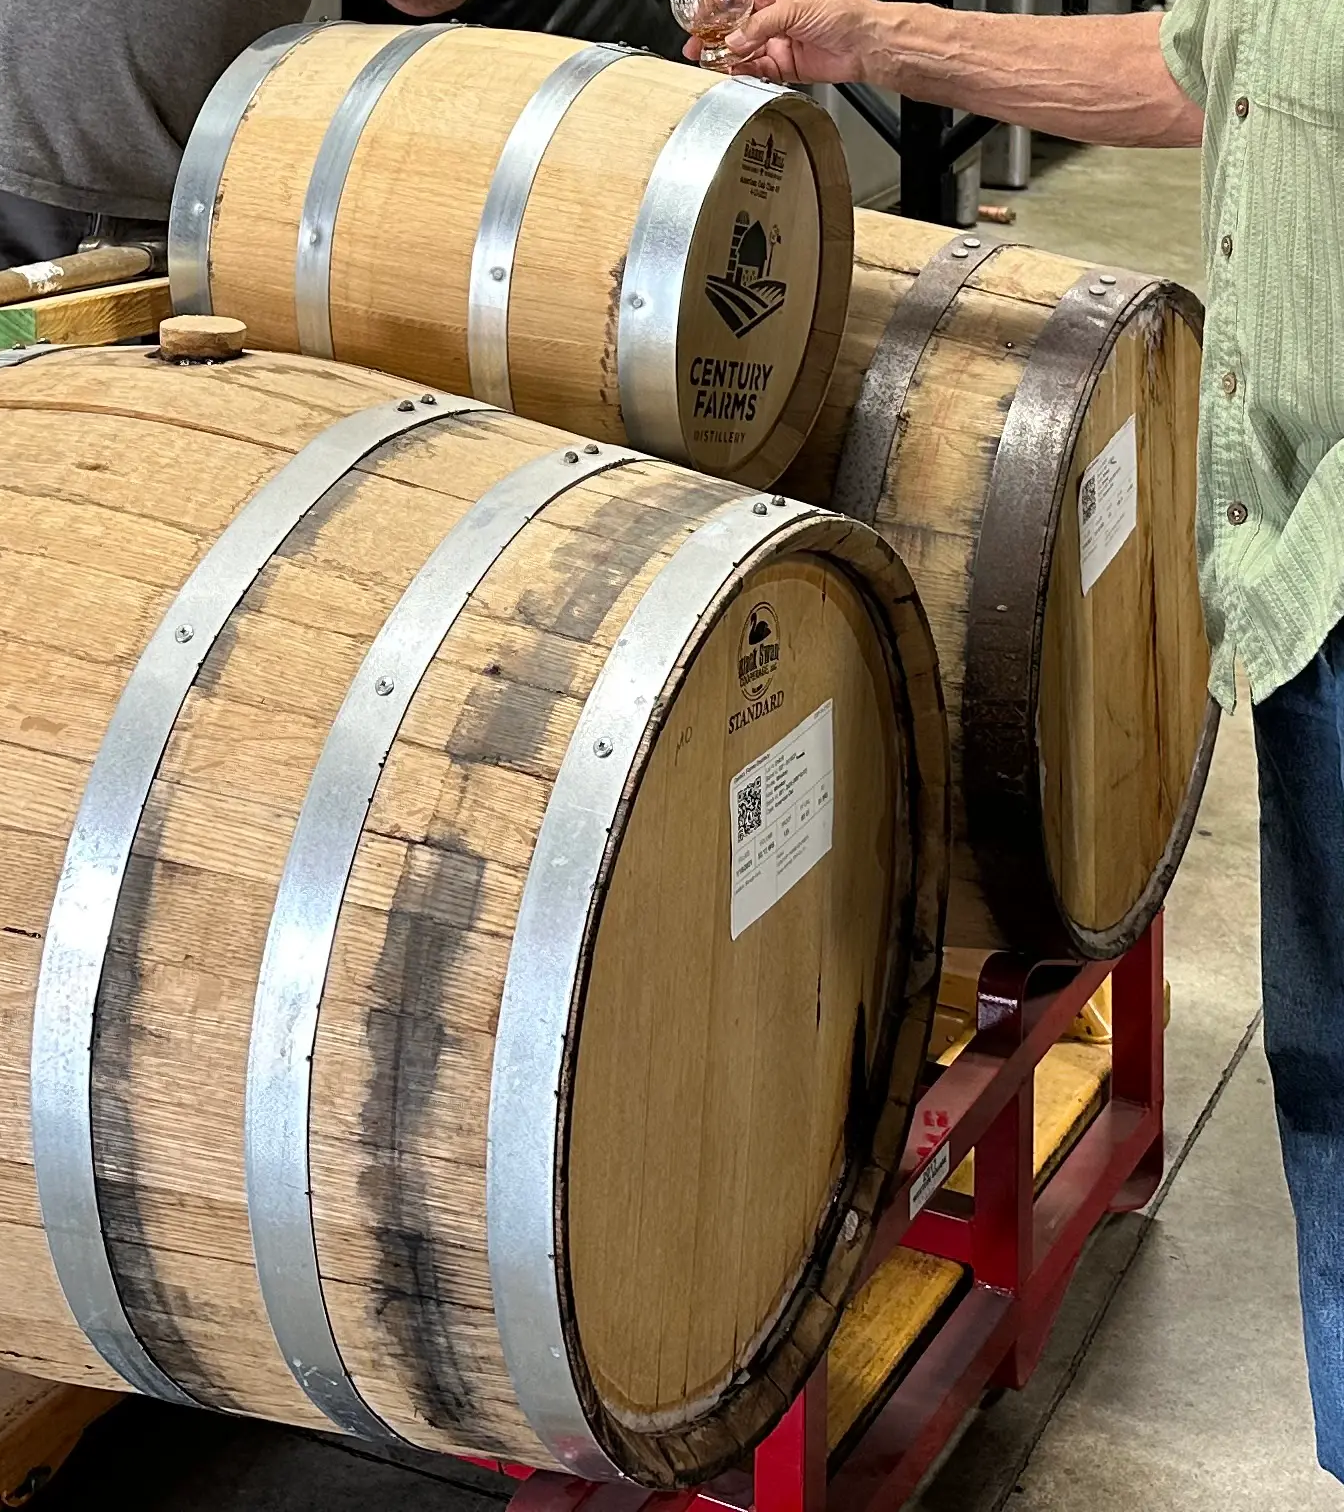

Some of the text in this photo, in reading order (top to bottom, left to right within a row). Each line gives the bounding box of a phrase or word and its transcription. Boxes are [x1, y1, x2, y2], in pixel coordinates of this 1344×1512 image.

[689, 356, 774, 392] CENTURY
[693, 389, 758, 422] FARMS
[693, 429, 747, 444] DISTILLERY
[728, 690, 786, 735] STANDARD
